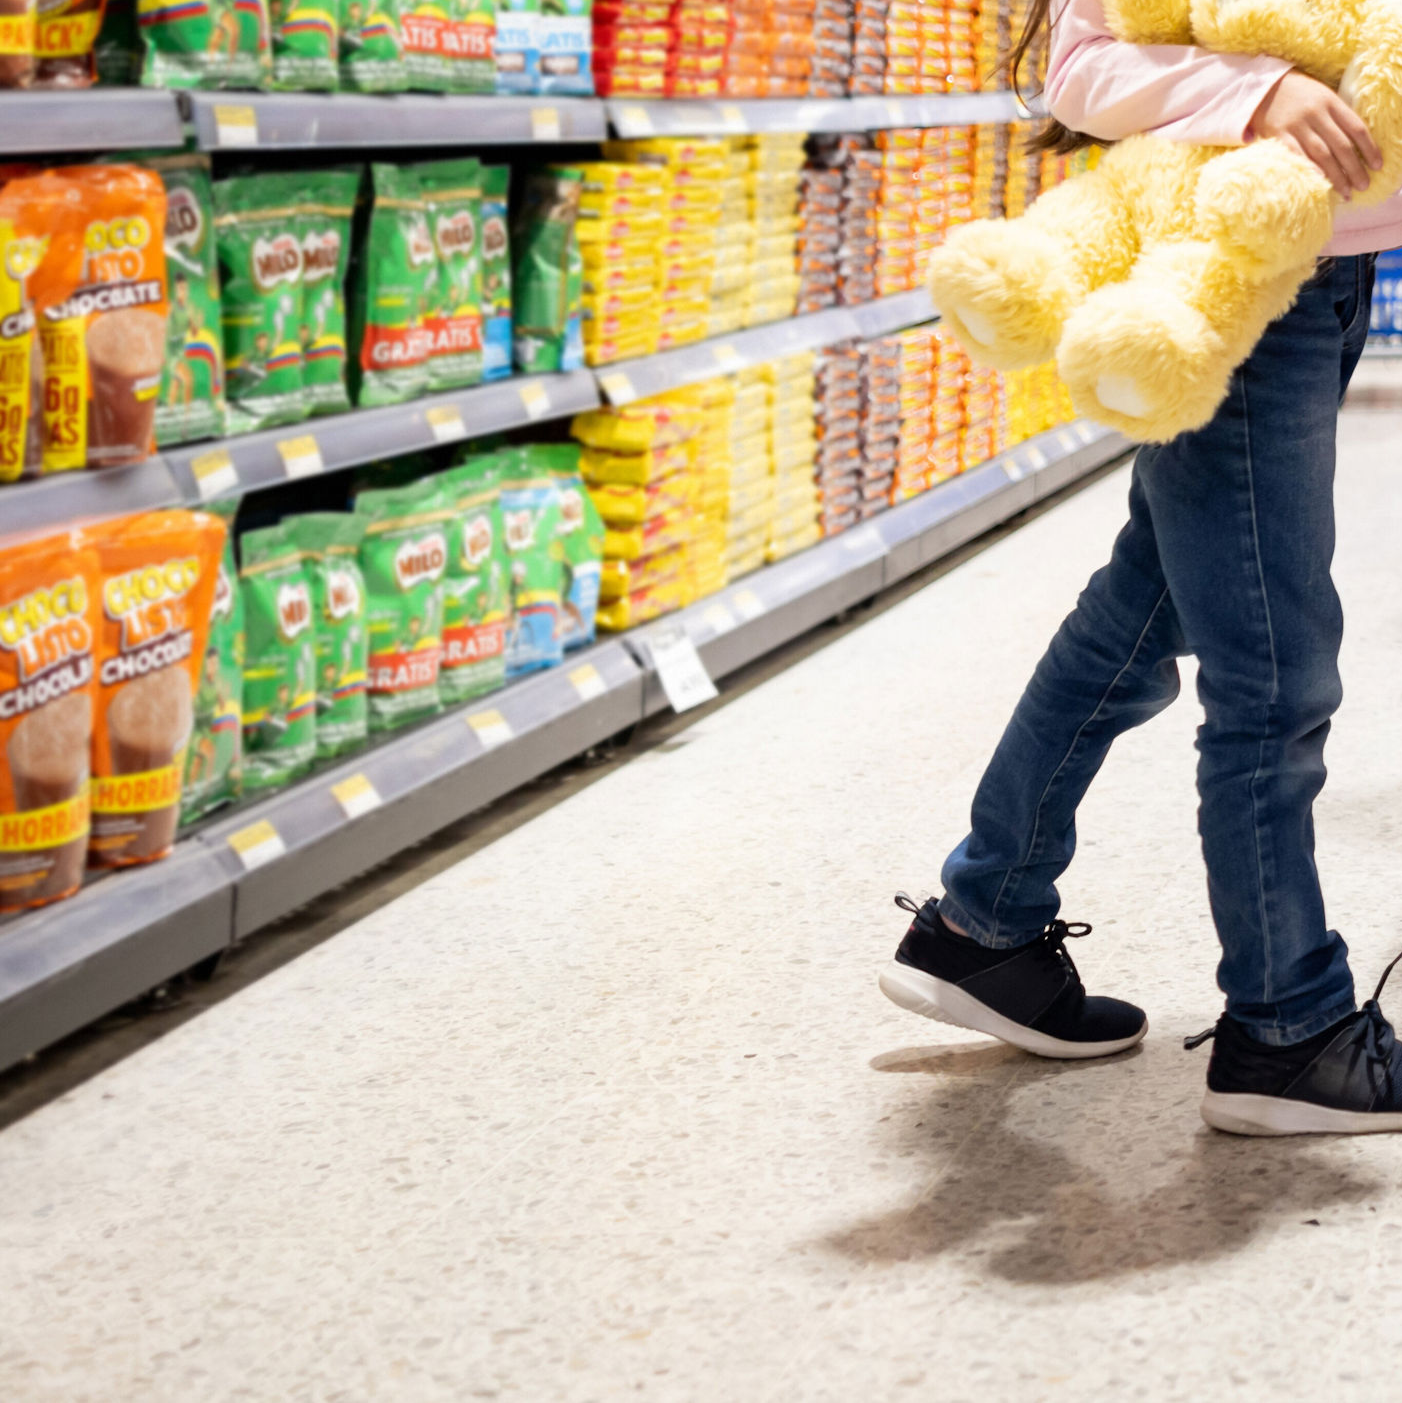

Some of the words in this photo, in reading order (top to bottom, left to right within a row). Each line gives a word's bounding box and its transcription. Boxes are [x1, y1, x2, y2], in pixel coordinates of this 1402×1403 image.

[441, 225, 473, 246] MILO
[256, 248, 299, 280] MILO
[399, 552, 443, 578] MILO
